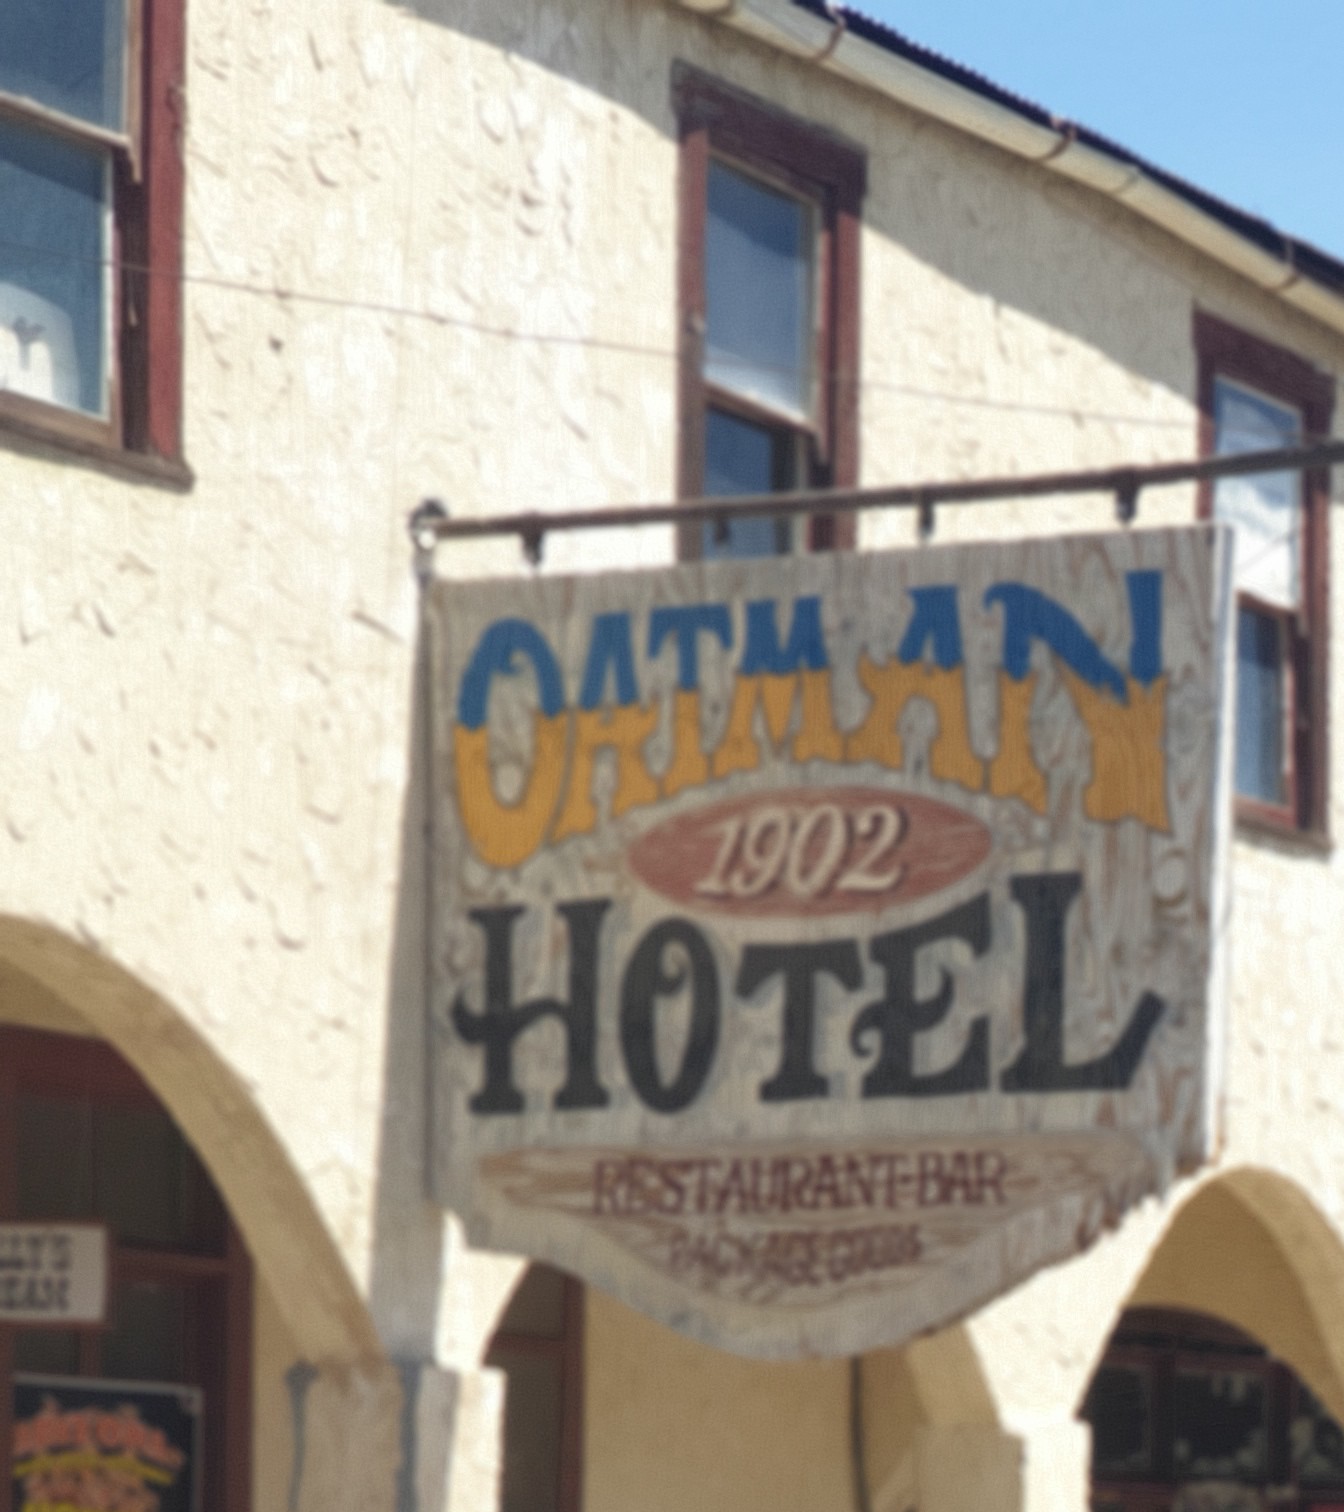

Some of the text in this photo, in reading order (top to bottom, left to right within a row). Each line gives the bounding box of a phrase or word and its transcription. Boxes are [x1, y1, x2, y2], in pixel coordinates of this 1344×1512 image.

[455, 570, 1175, 867] OATMAN
[693, 803, 908, 896] 1902
[450, 871, 1167, 1116] HOTEL
